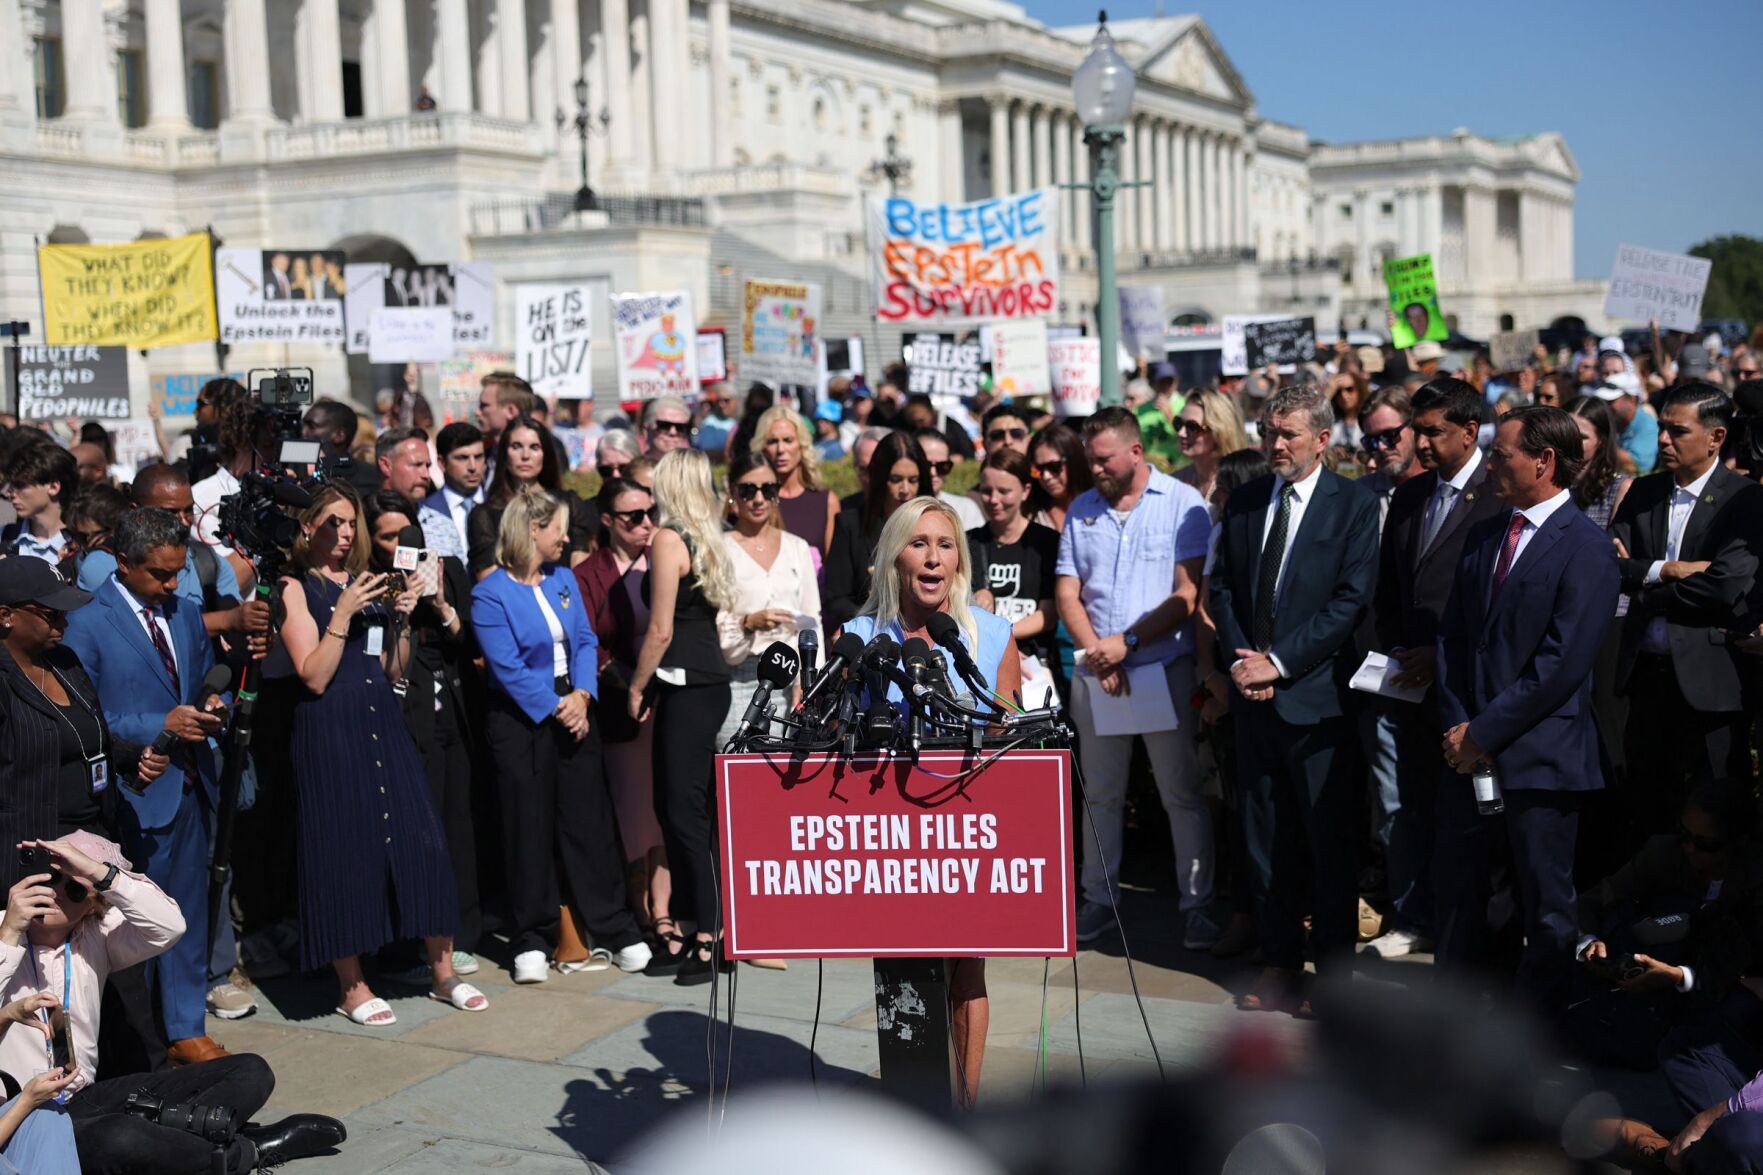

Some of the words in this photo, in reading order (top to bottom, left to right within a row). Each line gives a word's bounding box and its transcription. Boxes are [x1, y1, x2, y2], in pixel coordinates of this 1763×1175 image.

[885, 192, 1045, 250] BELIEVE
[82, 254, 133, 273] WHAT
[142, 250, 171, 270] DID
[64, 277, 113, 296] THEY
[88, 302, 138, 320] WHEN
[146, 295, 177, 313] DID
[235, 305, 300, 319] Unlock
[306, 305, 335, 317] the
[528, 297, 556, 325] HE
[562, 289, 582, 315] IS
[62, 324, 105, 341] THEY
[113, 318, 169, 337] KNOW
[223, 325, 293, 340] Epstein
[298, 325, 343, 337] Files
[532, 322, 557, 344] ON
[21, 344, 101, 364] NEUTER
[912, 341, 981, 370] RELEASE
[19, 368, 96, 384] GRAND
[21, 384, 64, 398] OLD
[18, 396, 130, 419] PEDOPHILES
[771, 652, 796, 675] svt
[790, 814, 910, 851] EPSTEIN
[920, 813, 997, 850] FILES
[745, 858, 980, 896] TRANSPARENCY
[990, 858, 1046, 894] ACT
